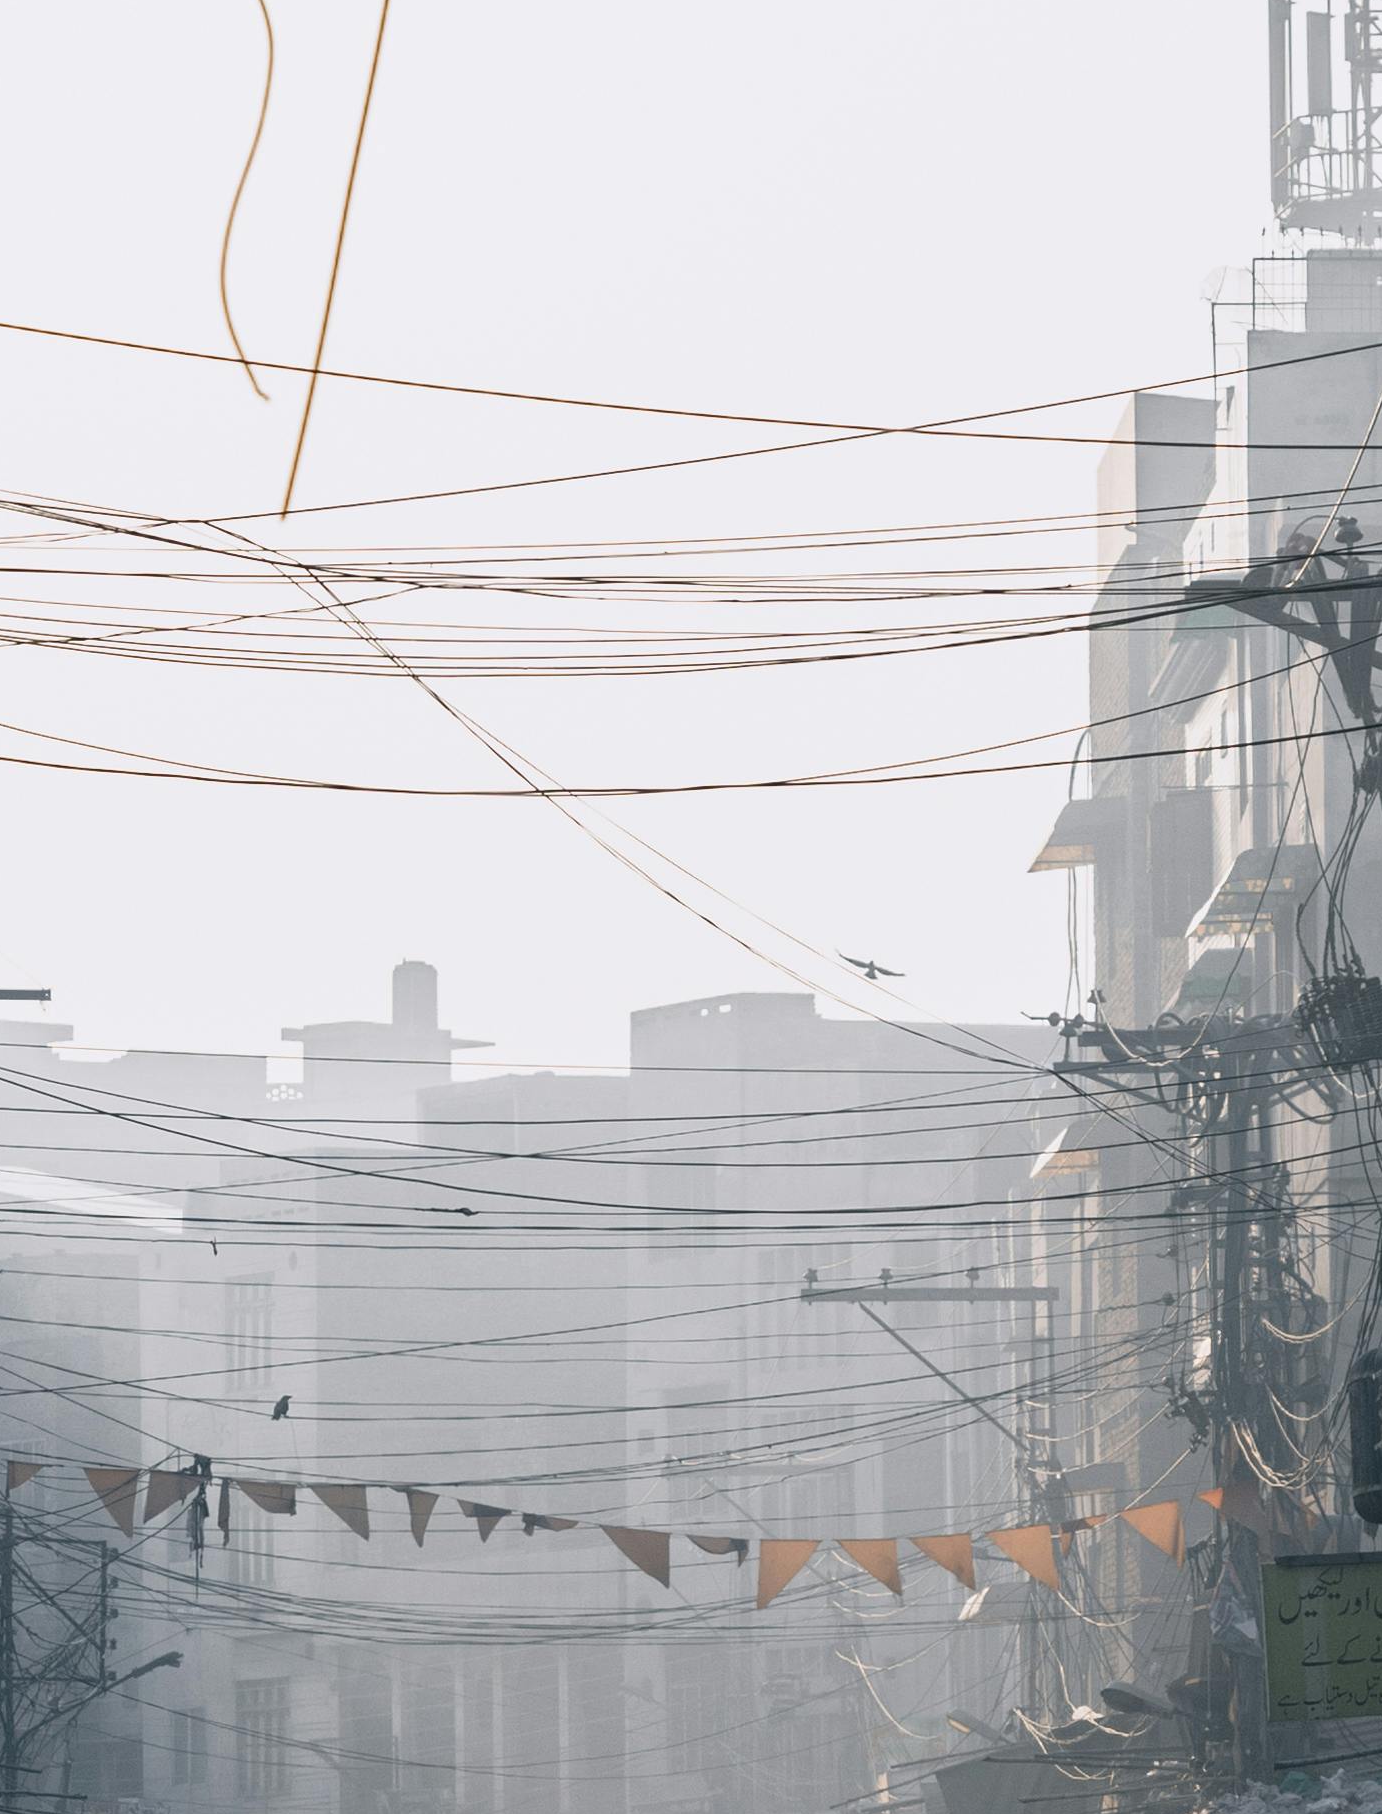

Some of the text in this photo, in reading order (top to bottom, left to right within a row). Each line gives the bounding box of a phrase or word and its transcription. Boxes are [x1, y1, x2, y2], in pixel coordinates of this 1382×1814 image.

[1337, 1586, 1370, 1617] اور
[1336, 1634, 1367, 1665] کے
[1303, 1684, 1354, 1712] دستیاب
